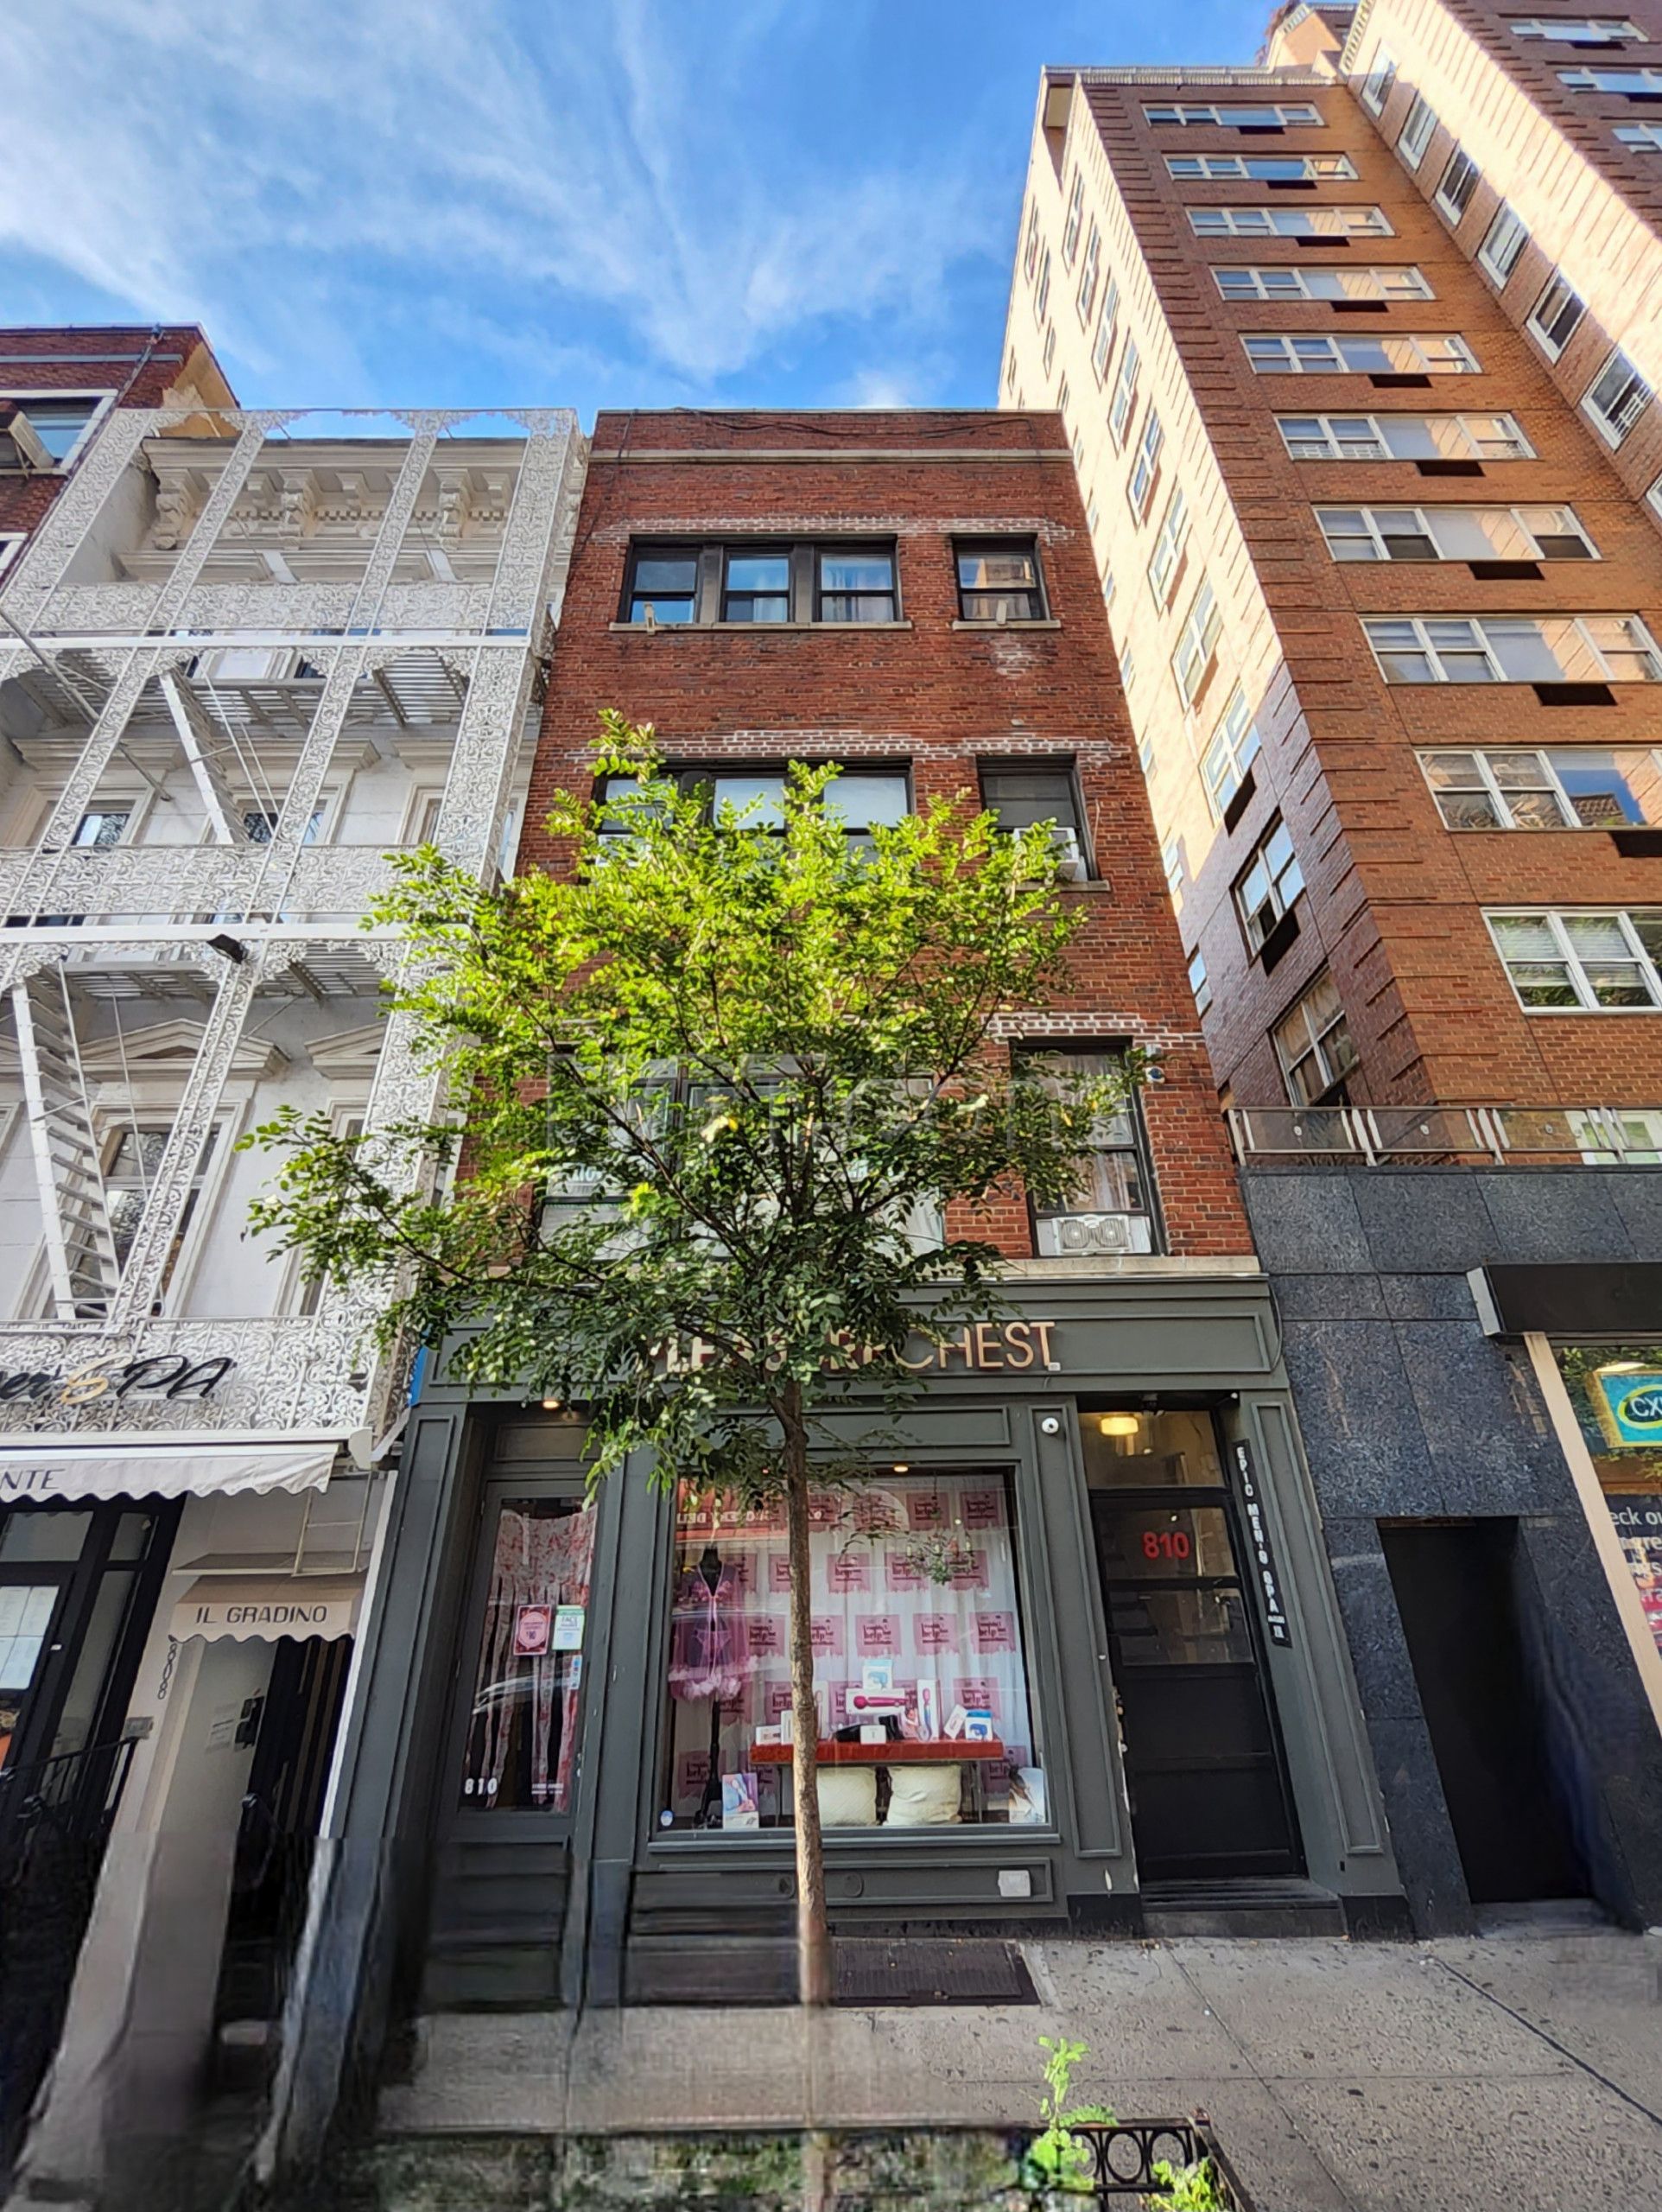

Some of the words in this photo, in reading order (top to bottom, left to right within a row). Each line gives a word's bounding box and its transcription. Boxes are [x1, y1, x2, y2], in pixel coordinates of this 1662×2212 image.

[60, 1353, 234, 1405] SPA
[0, 1468, 66, 1491] NTE
[1142, 1532, 1190, 1559] 810
[196, 1606, 216, 1624] IL
[227, 1606, 327, 1624] GRADINO
[465, 1777, 498, 1795] 810
